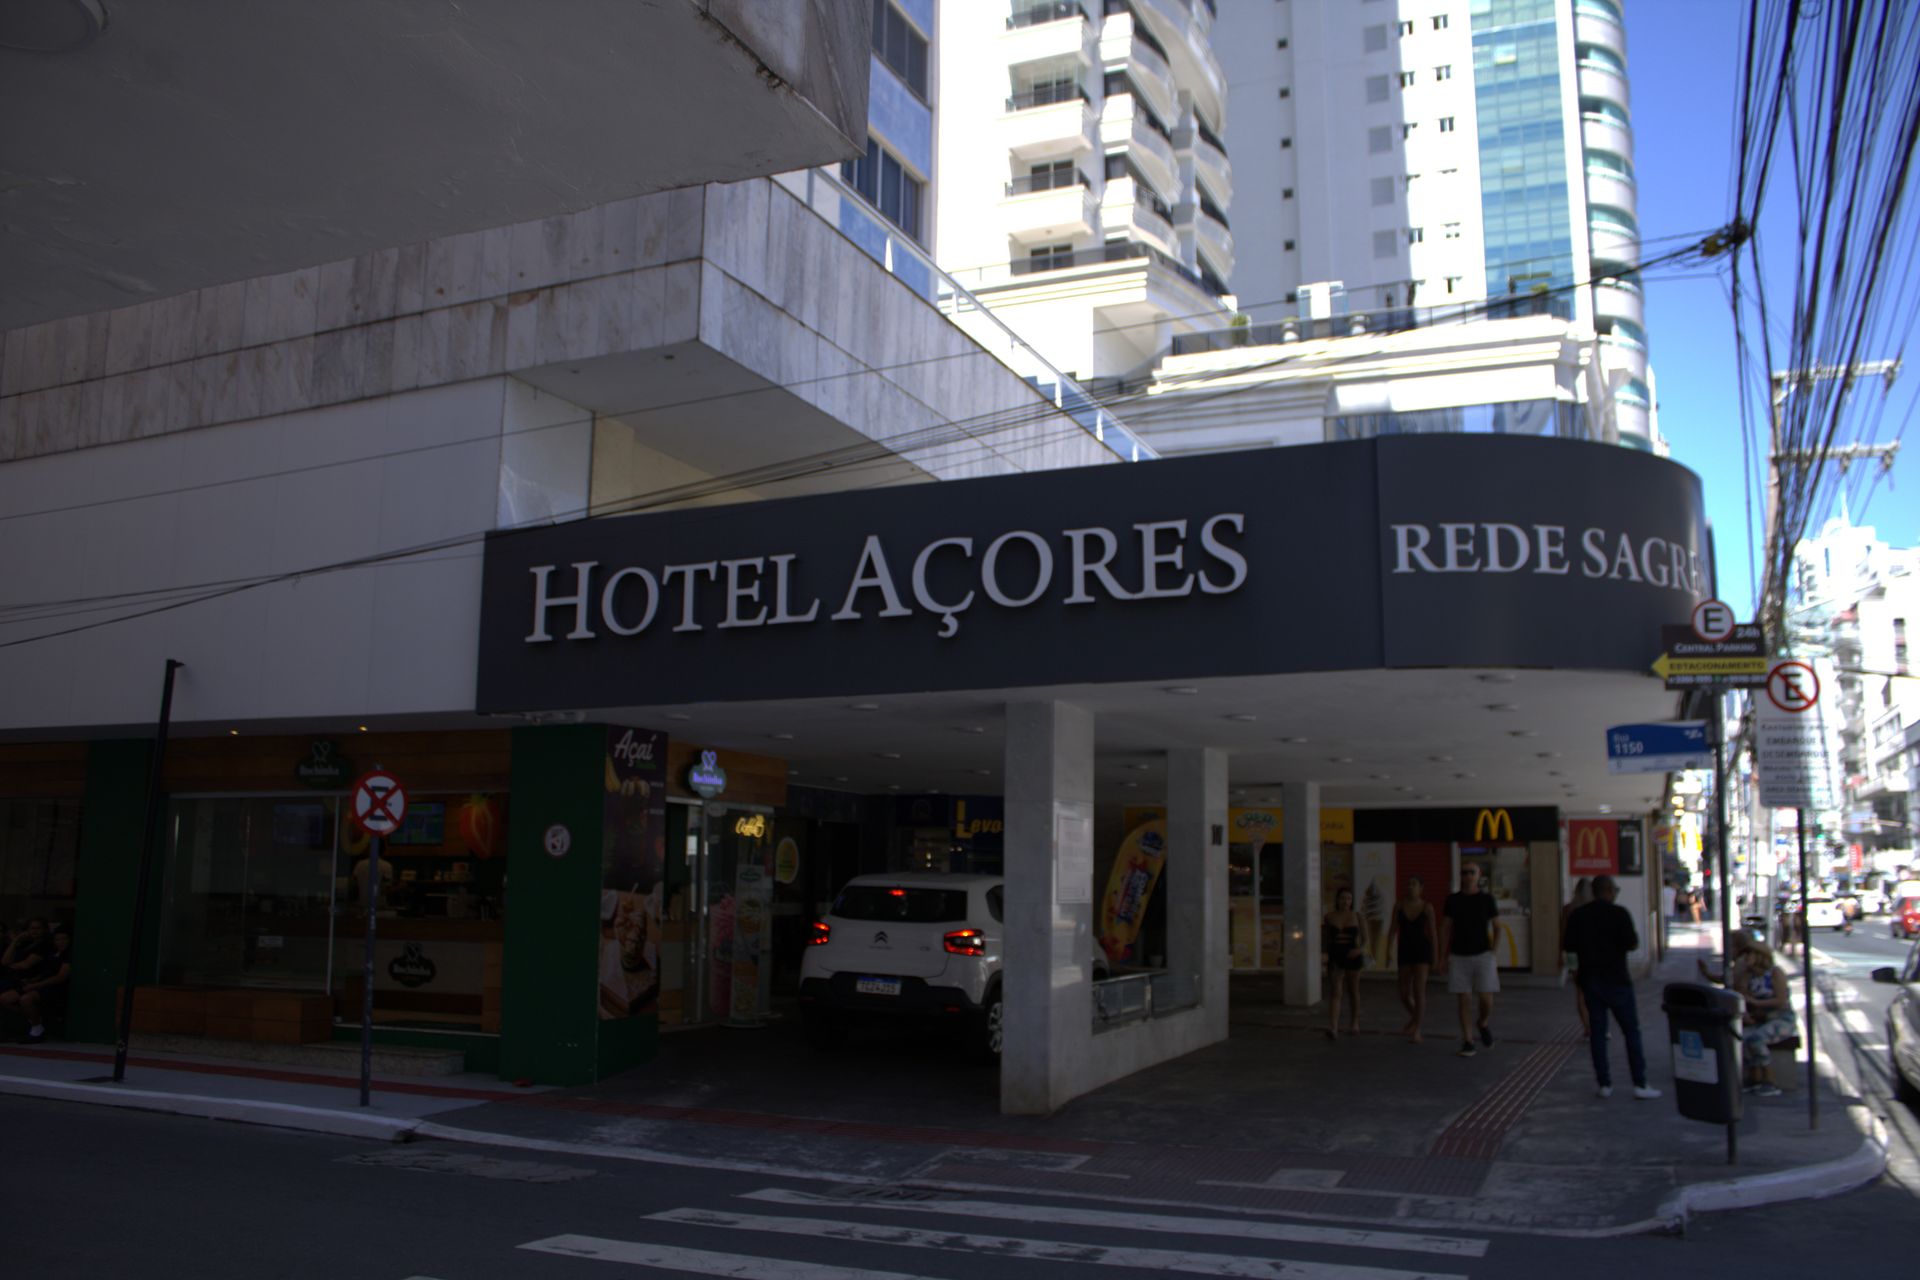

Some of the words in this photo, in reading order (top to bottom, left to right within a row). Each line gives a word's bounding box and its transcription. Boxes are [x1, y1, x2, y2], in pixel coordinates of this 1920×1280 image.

[1390, 523, 1570, 575] REDE
[525, 553, 820, 642] HOTEL
[830, 513, 1248, 638] AÇORES
[1703, 608, 1724, 633] E
[1669, 661, 1764, 671] ESTACIONAMENTO
[614, 728, 657, 768] Açaí
[1614, 741, 1644, 755] 1150
